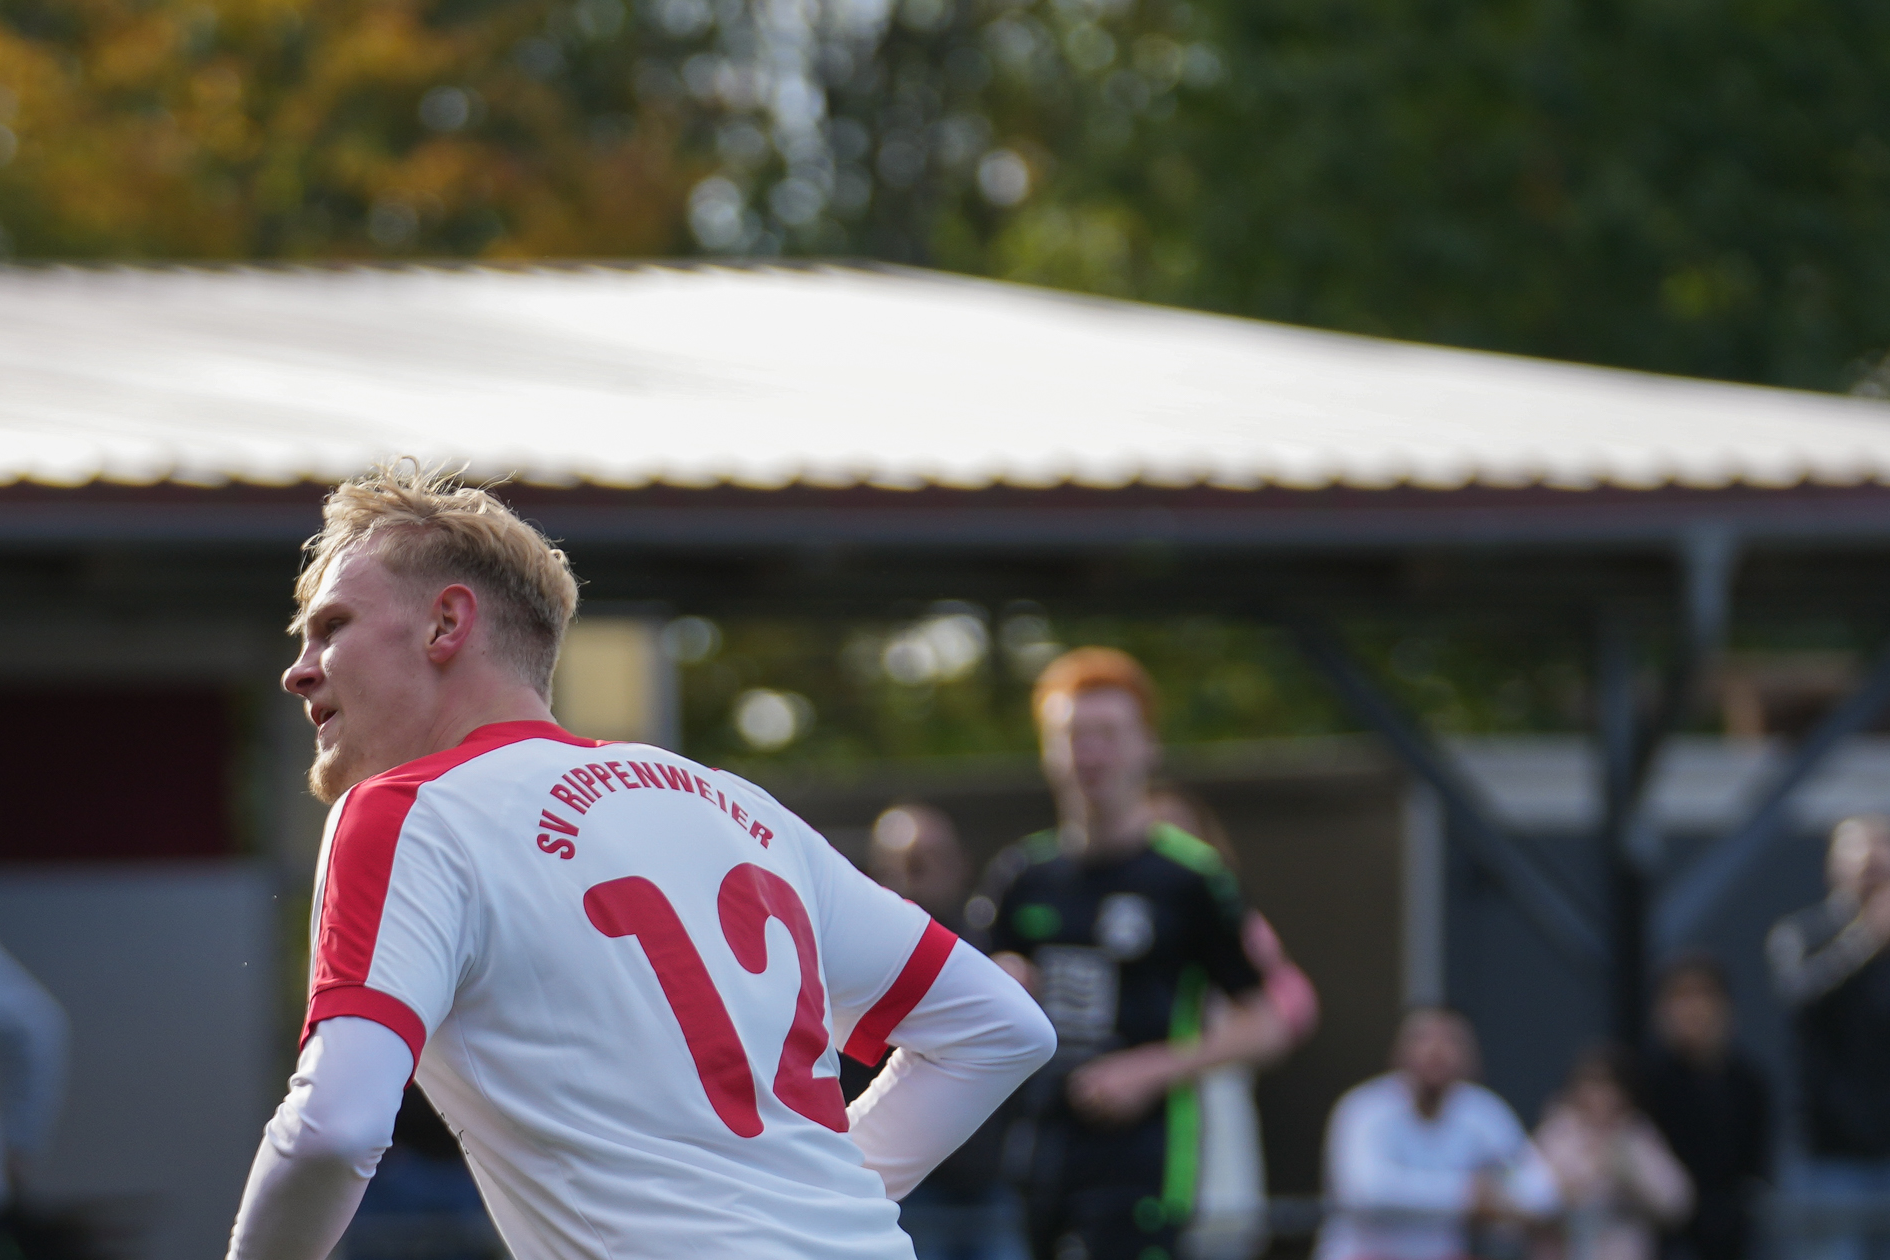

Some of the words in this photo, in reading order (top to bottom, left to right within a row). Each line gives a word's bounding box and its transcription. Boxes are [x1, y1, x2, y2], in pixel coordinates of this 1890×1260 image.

[537, 809, 580, 860] SV
[550, 760, 774, 849] RIPPENWEIER
[583, 862, 849, 1138] 12
